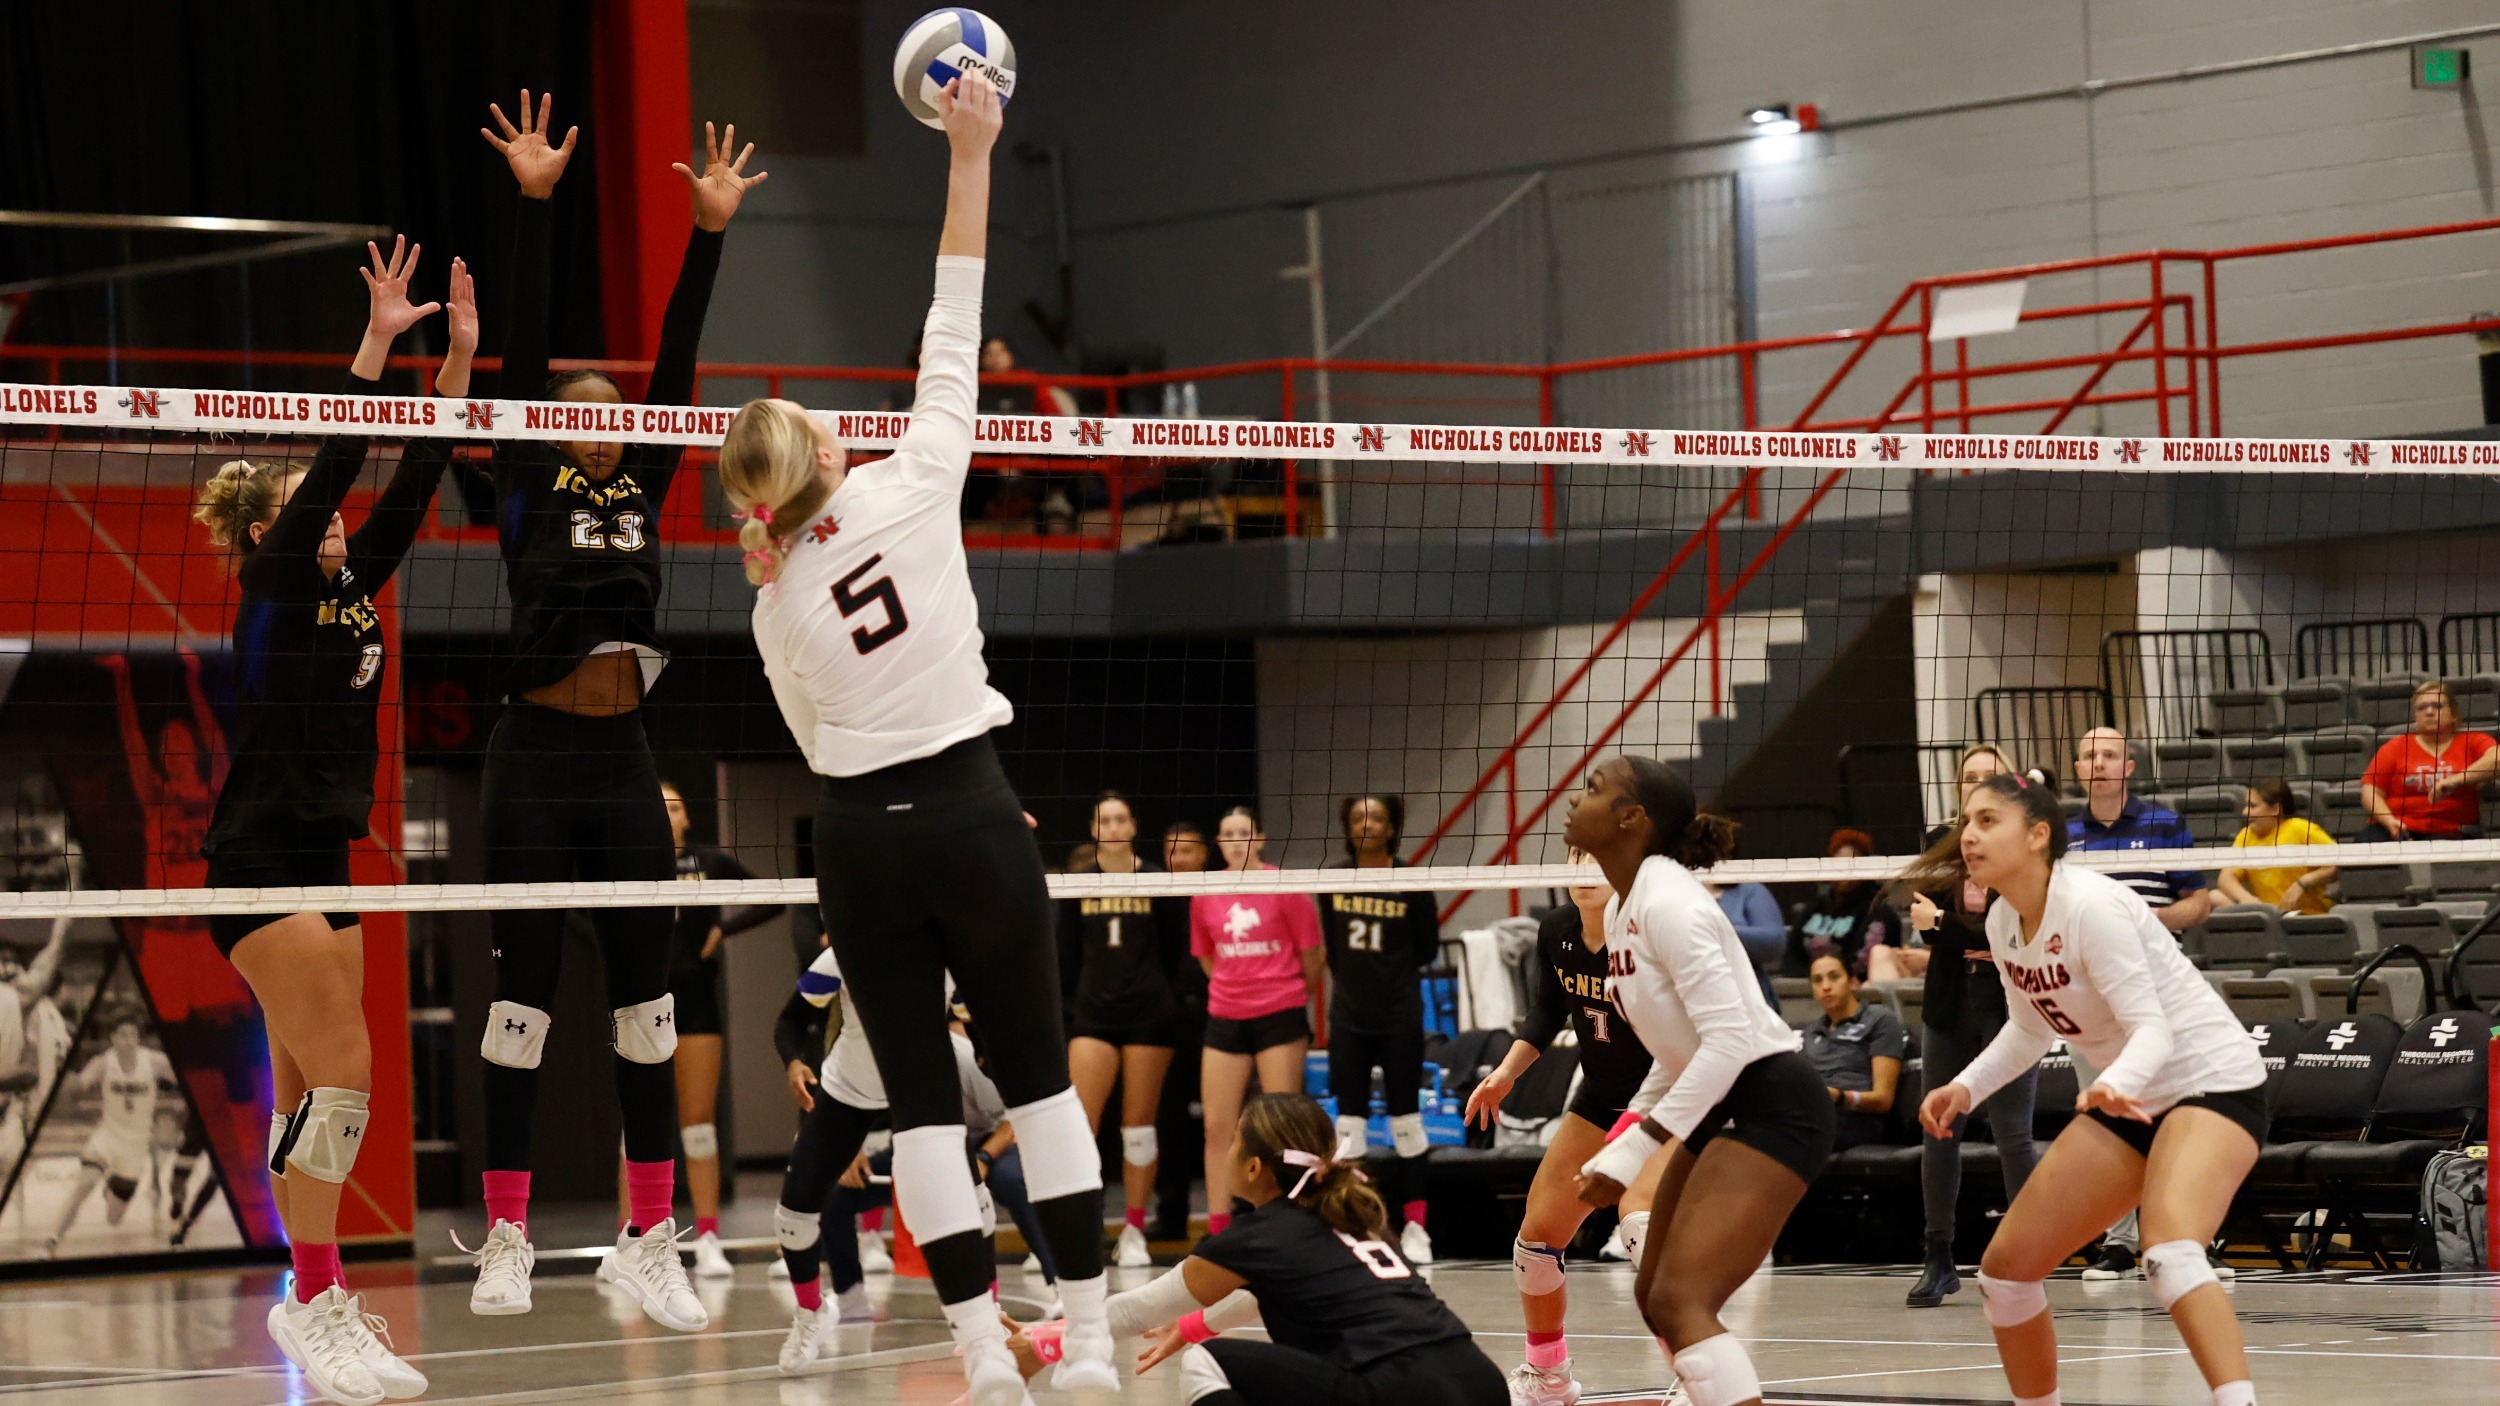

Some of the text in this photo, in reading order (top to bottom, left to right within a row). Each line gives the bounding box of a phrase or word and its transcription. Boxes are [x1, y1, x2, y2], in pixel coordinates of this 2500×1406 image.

[0, 388, 97, 414] LONELS
[194, 393, 310, 421] NICHOLLS
[318, 398, 436, 426] COLONELS
[525, 405, 636, 432] NICHOLLS
[838, 415, 910, 439] NICHO
[975, 419, 1053, 443] LONELS
[1132, 423, 1230, 447] NICHOLLS
[1235, 424, 1336, 449] COLONELS
[1410, 428, 1503, 452] NICHOLLS
[1509, 431, 1603, 453] COLONELS
[1674, 434, 1762, 457] NICHOLLS
[1767, 436, 1857, 459] COLONELS
[1922, 438, 2009, 460] NICHOLLS
[2014, 439, 2099, 462] COLONELS
[2162, 442, 2244, 463] NICHOLLS
[2248, 442, 2331, 464] COLONELS
[2391, 444, 2468, 465] NICHOLLS
[2473, 445, 2500, 465] COL
[570, 509, 646, 552] 23
[830, 552, 909, 656] 5
[350, 643, 384, 689] 9
[1107, 915, 1122, 948] 1
[1347, 917, 1383, 953] 21
[1583, 1005, 1611, 1043] 7
[2030, 997, 2083, 1036] 16
[2264, 1062, 2286, 1070] TEM
[2298, 1053, 2337, 1061] THIBODAUX
[2397, 1055, 2474, 1065] HEALTH SYSTEM
[2400, 1049, 2475, 1059] THIBODAUX REGIONAL
